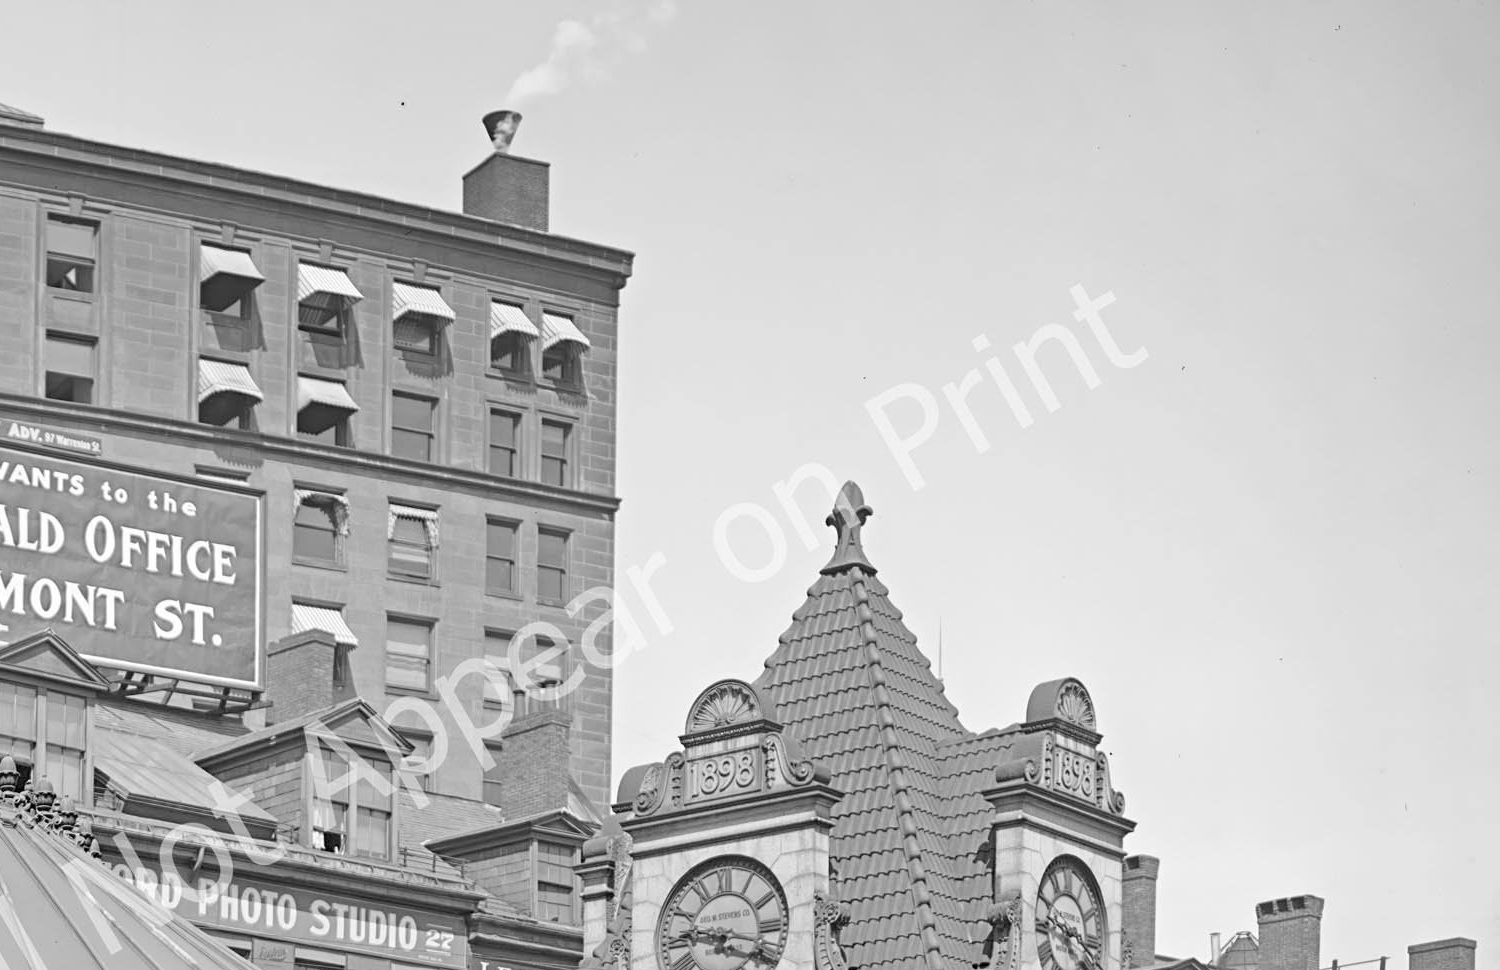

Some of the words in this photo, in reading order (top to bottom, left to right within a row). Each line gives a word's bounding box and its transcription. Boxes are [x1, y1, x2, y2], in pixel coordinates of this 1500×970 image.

[8, 421, 43, 442] ADV.
[101, 481, 129, 505] to
[147, 488, 198, 517] the
[83, 514, 238, 585] OFFICE
[152, 599, 224, 648] ST.
[690, 755, 755, 798] 1898
[1055, 749, 1093, 798] 1898
[199, 879, 298, 932] PHOTO
[308, 898, 418, 951] STUDIO
